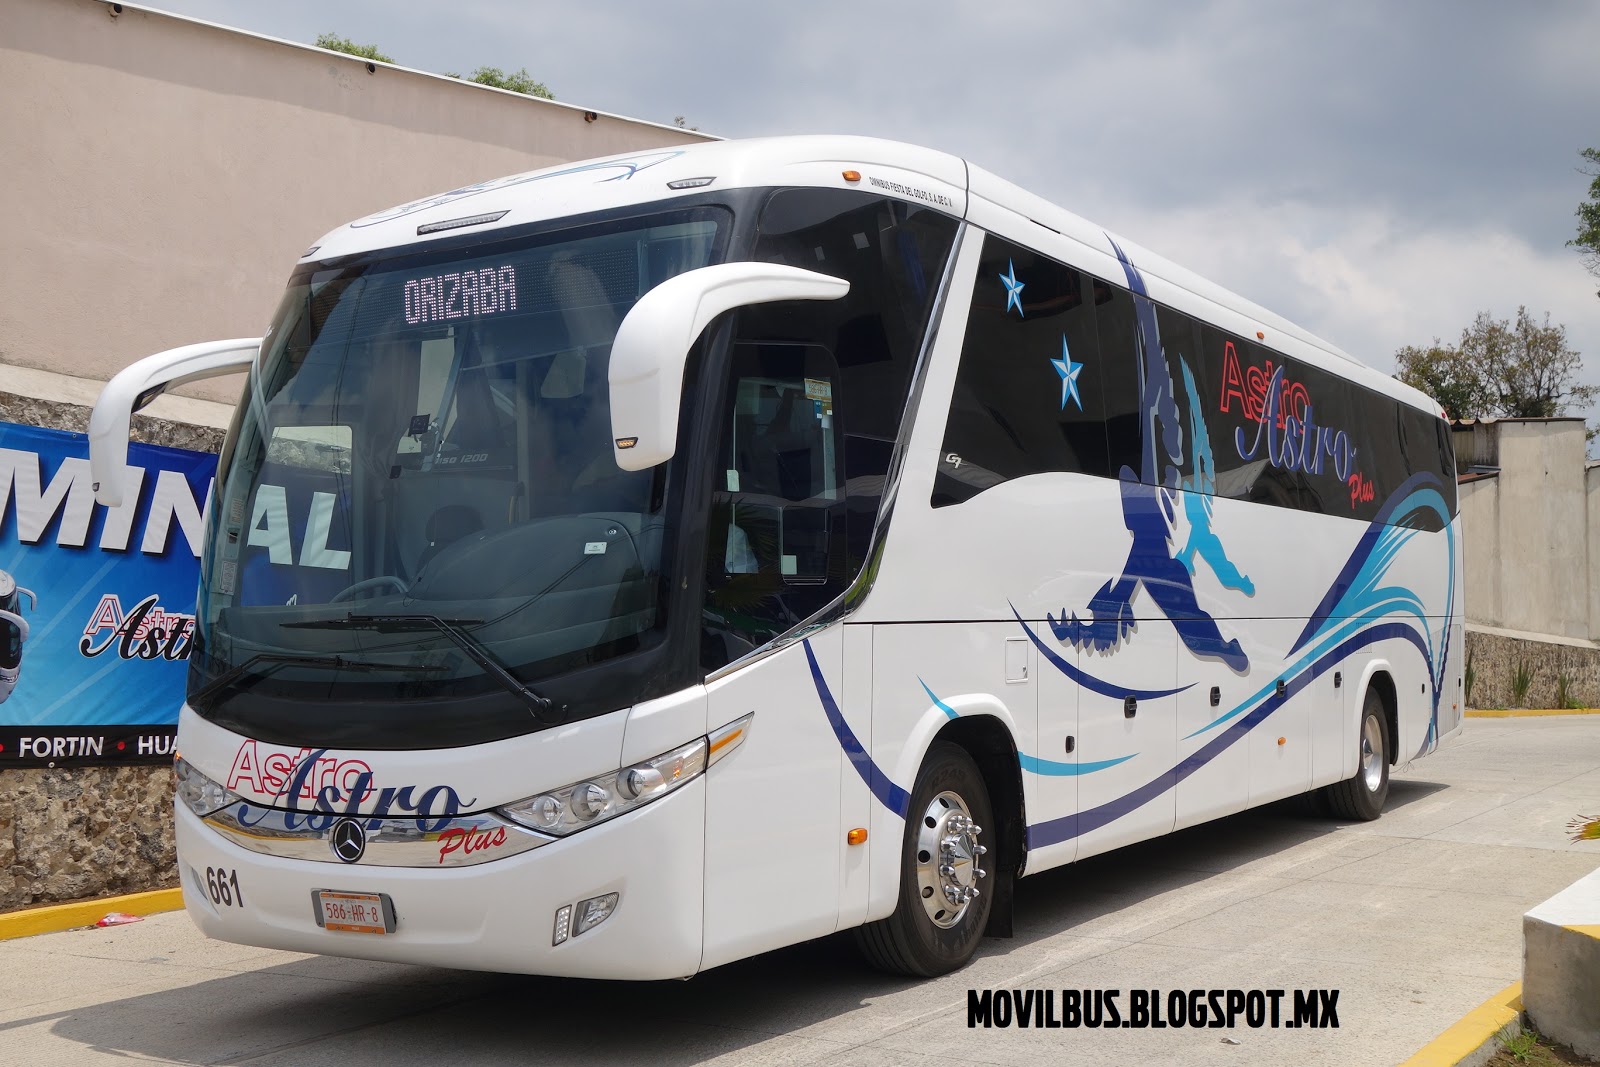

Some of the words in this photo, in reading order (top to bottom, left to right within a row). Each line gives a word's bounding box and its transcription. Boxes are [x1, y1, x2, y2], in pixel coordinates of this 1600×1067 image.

[890, 181, 906, 195] FIESTA
[904, 185, 914, 197] DEL
[404, 264, 517, 324] ORIZABA
[1220, 341, 1312, 434] Astro
[1235, 365, 1357, 482] Astro
[1348, 472, 1375, 509] Plus
[19, 736, 104, 757] FORTIN
[227, 739, 373, 803] Astro
[237, 749, 477, 832] Astro
[437, 825, 508, 864] Plus
[206, 866, 244, 908] 661
[325, 902, 379, 923] 586-HR-8
